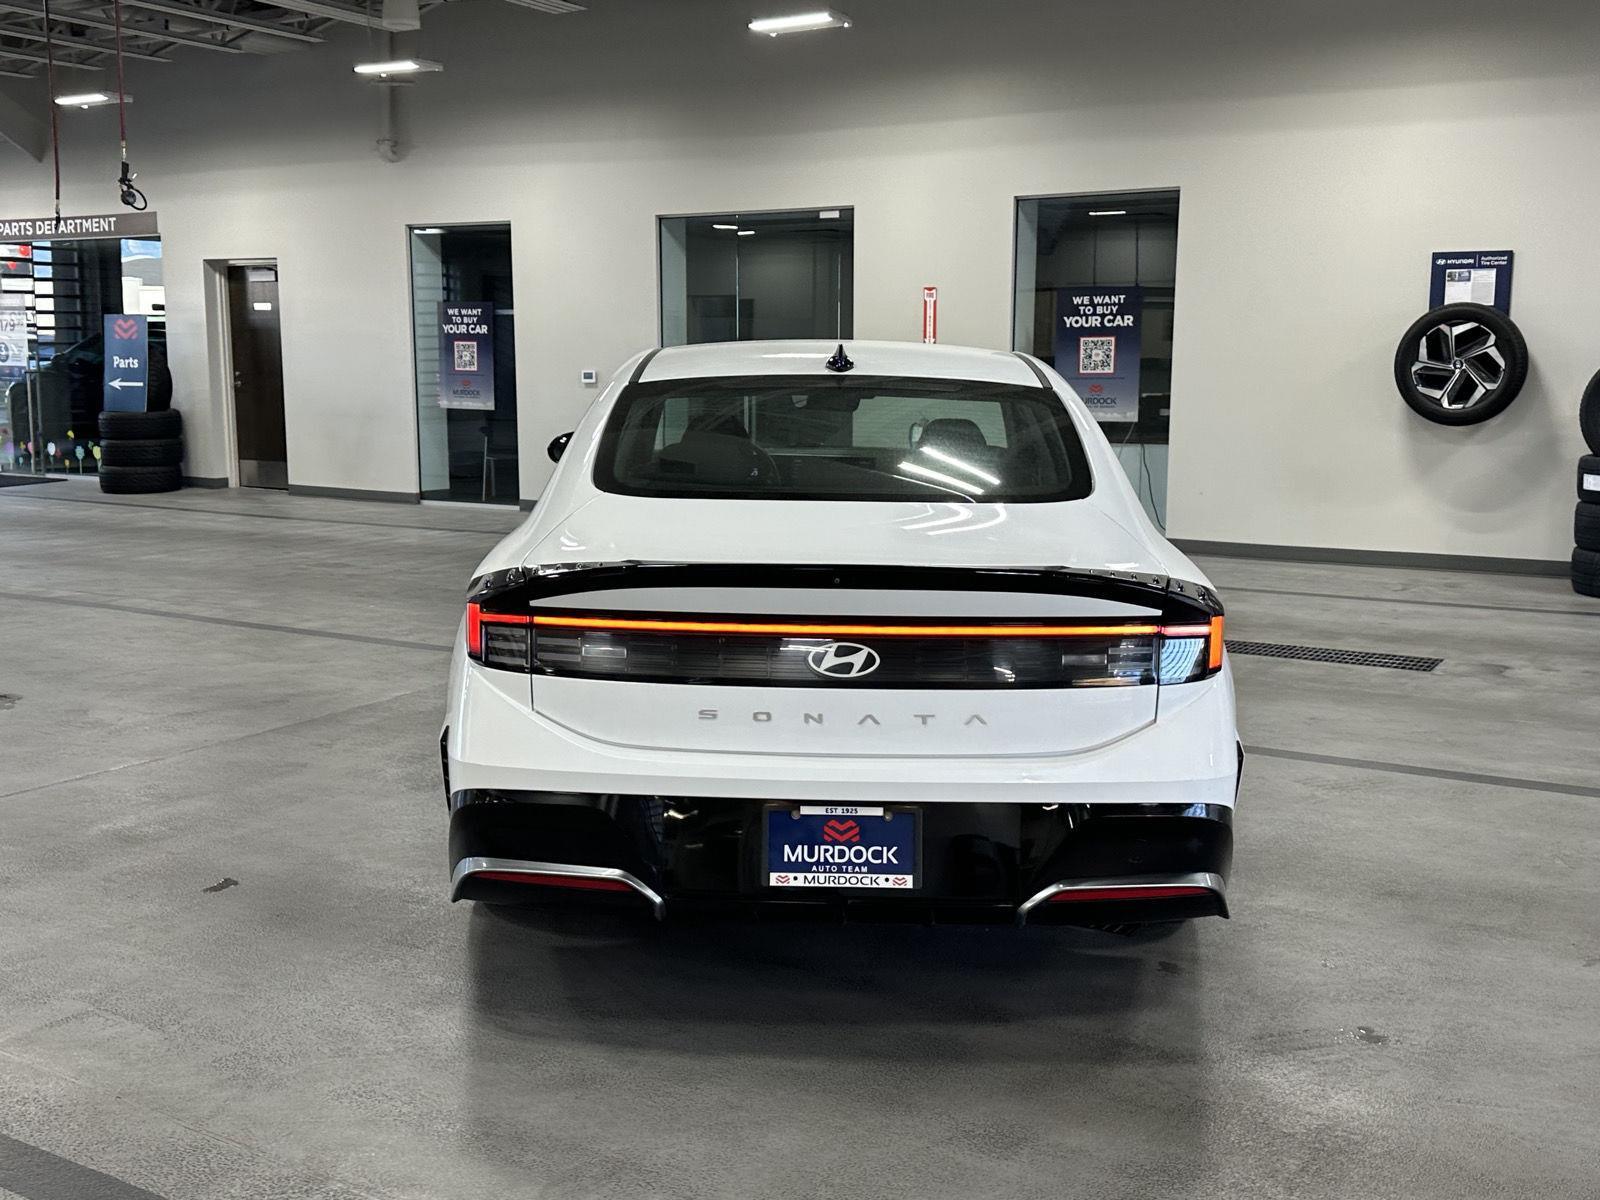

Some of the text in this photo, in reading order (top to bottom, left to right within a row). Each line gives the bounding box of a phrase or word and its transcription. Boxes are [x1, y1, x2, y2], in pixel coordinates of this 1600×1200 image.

[1072, 295, 1126, 305] WE WANT
[447, 308, 482, 316] WE WANT
[1079, 305, 1118, 315] TO BUY
[1063, 315, 1134, 328] YOUR CAR
[442, 324, 488, 334] YOUR CAR
[112, 355, 139, 369] Parts
[698, 709, 988, 726] SONATA
[783, 844, 899, 865] MURDOCK
[811, 865, 868, 873] AUTO TEAM
[803, 874, 880, 886] MURDOCK
